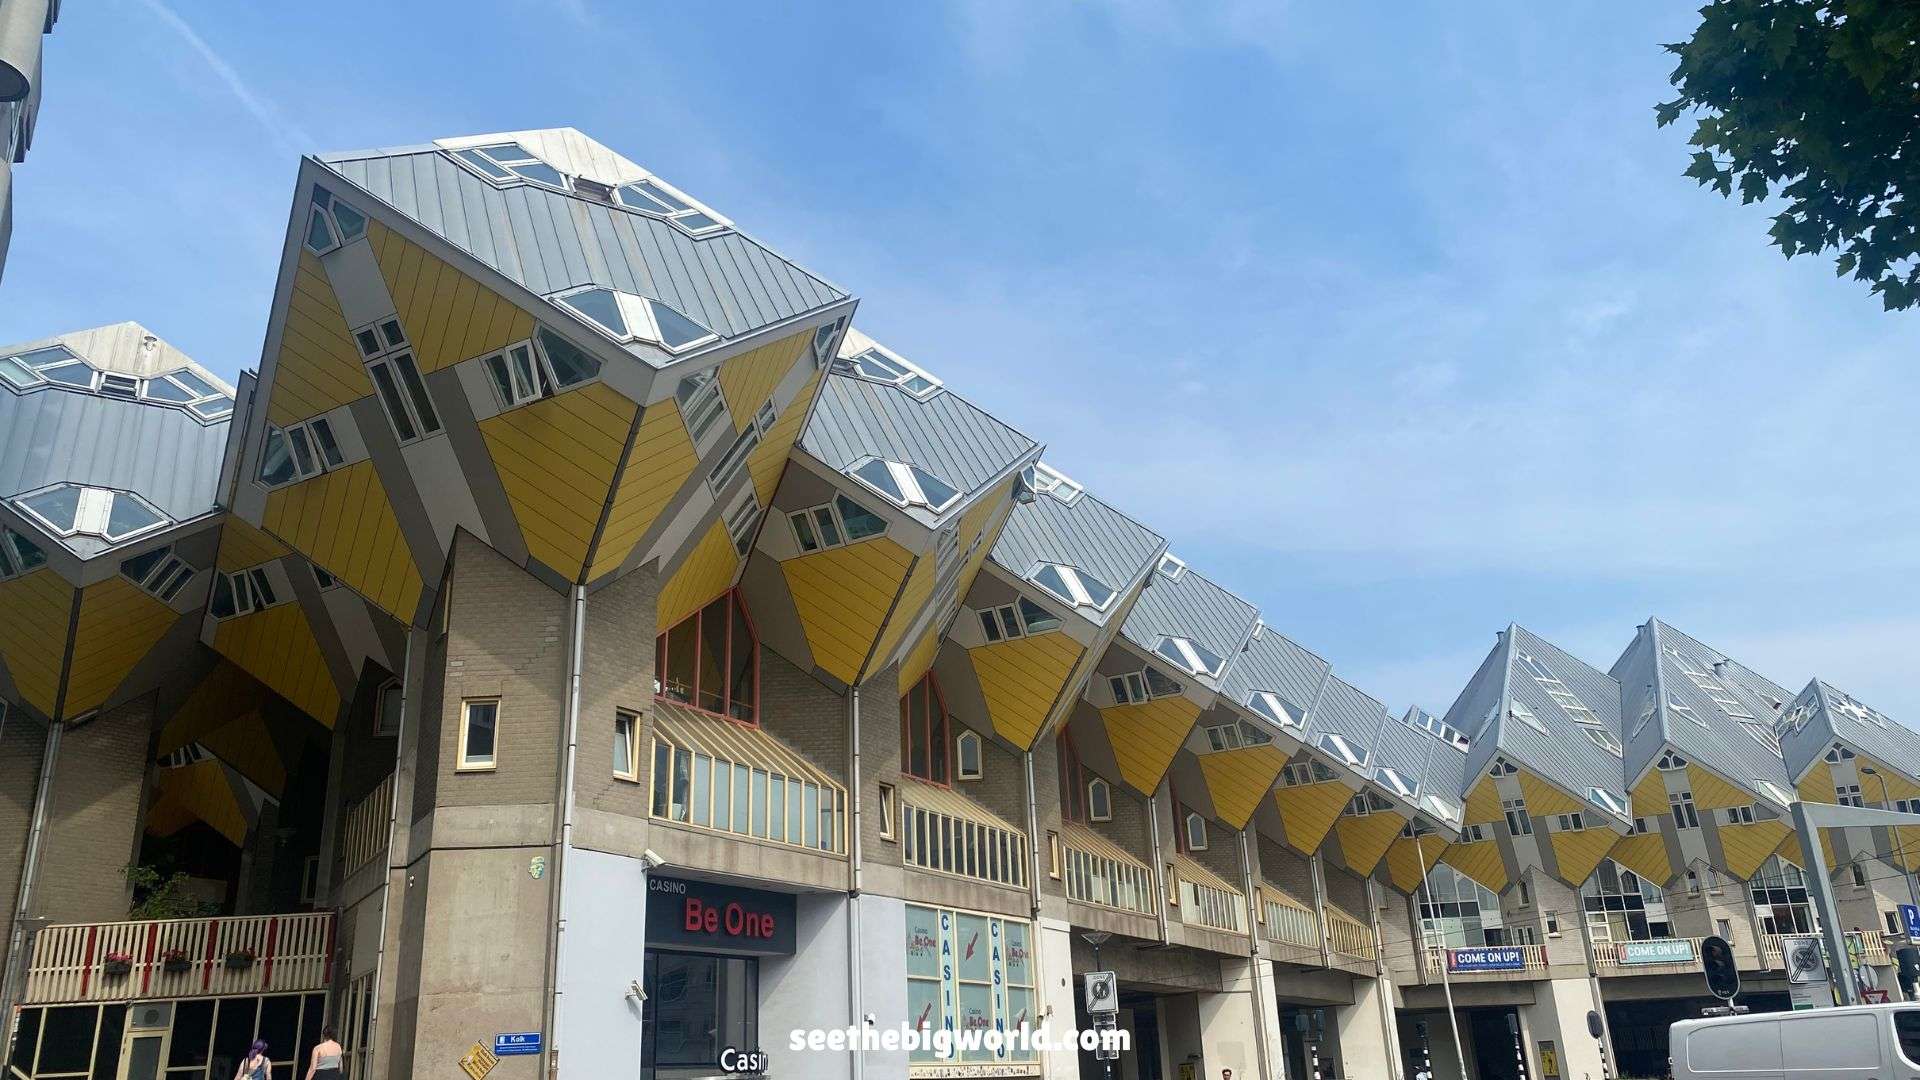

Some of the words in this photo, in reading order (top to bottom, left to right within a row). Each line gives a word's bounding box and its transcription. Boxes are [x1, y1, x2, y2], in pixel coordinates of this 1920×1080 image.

[649, 878, 686, 895] CASINO
[686, 898, 719, 933] Be
[725, 902, 775, 938] One
[1907, 908, 1915, 926] P
[1457, 952, 1486, 964] COME
[1487, 952, 1502, 963] ON
[1503, 951, 1520, 962] UP!
[1627, 945, 1655, 957] COME
[1657, 944, 1671, 956] ON
[1672, 943, 1690, 955] UP!
